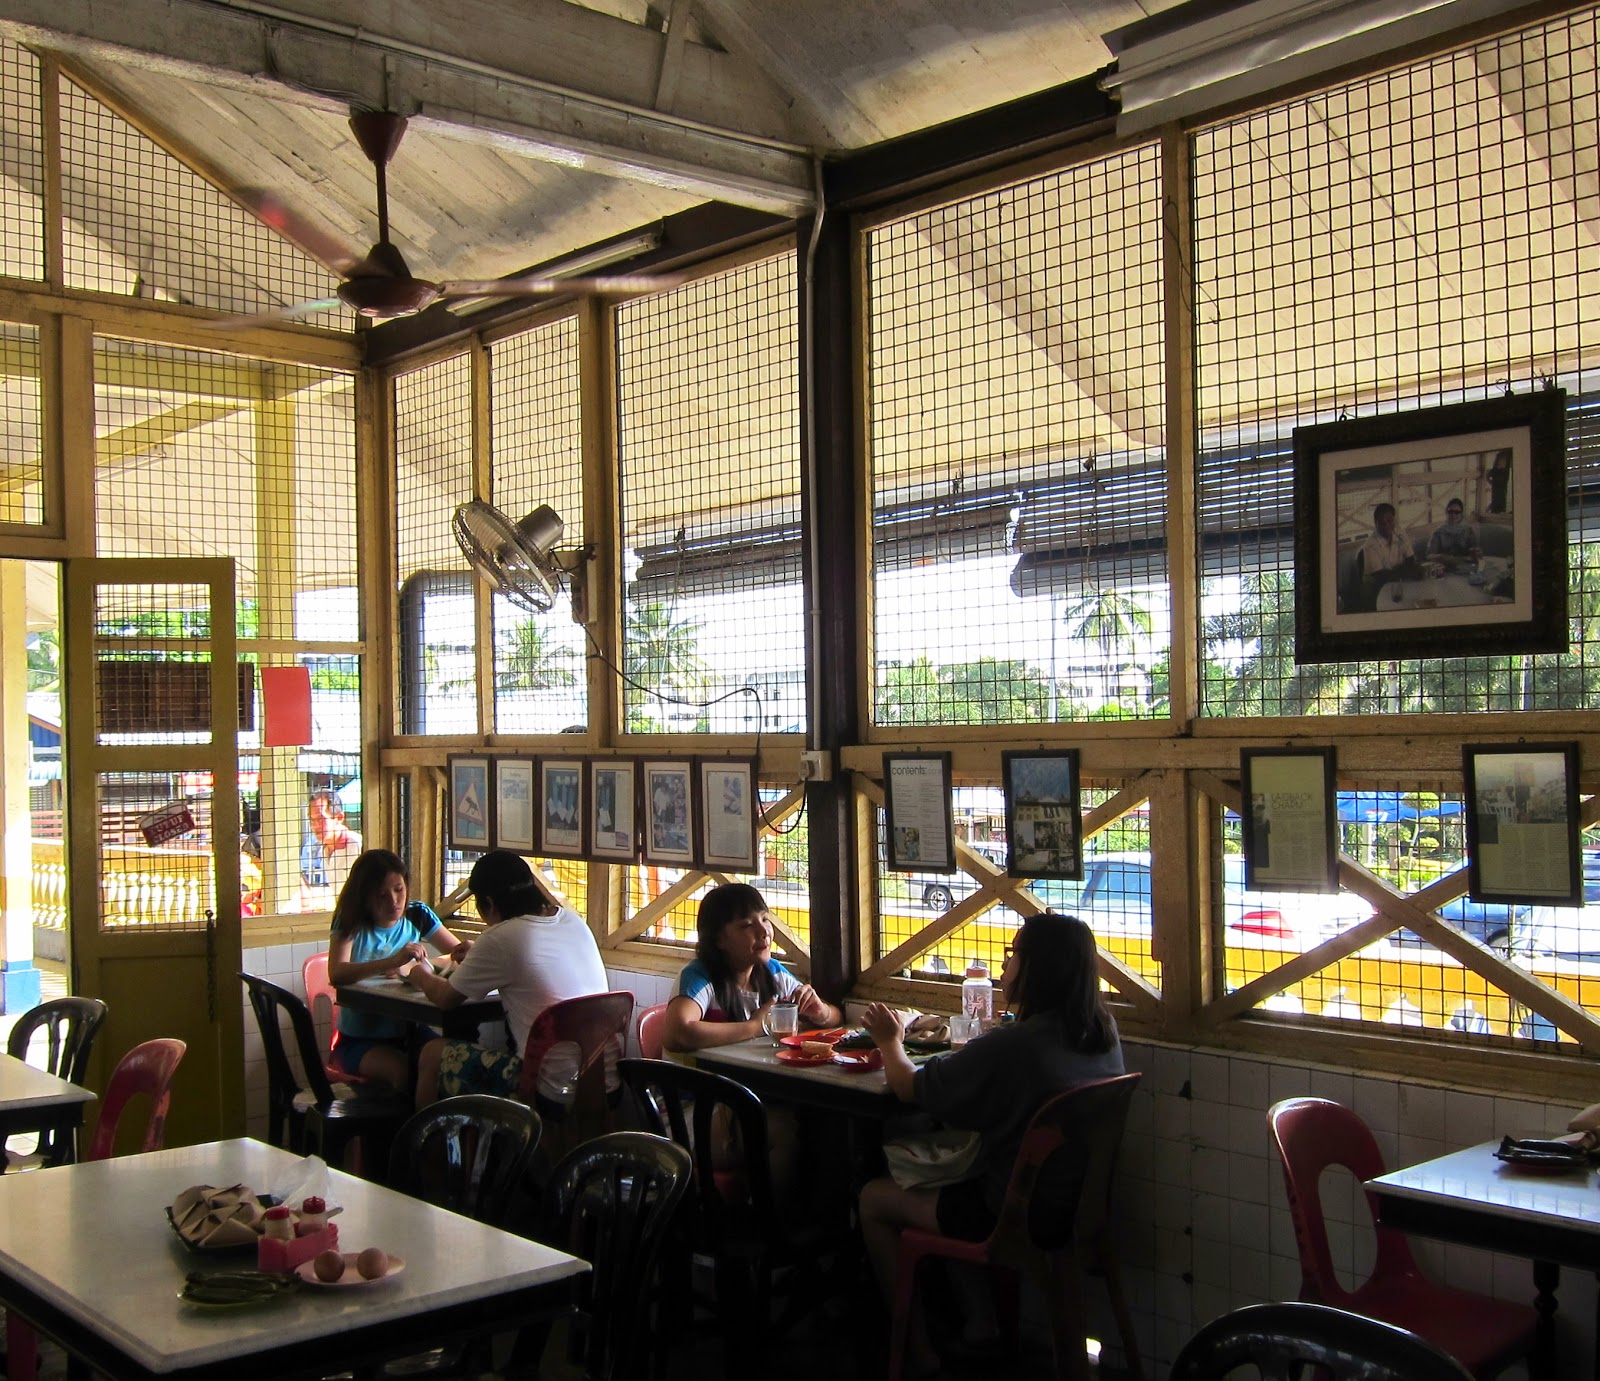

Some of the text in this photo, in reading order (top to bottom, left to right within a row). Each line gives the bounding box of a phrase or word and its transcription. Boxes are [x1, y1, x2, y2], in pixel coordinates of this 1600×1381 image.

[1271, 792, 1312, 801] LAIDBACK
[1271, 801, 1303, 810] CHARM
[152, 822, 189, 843] CLOSED
